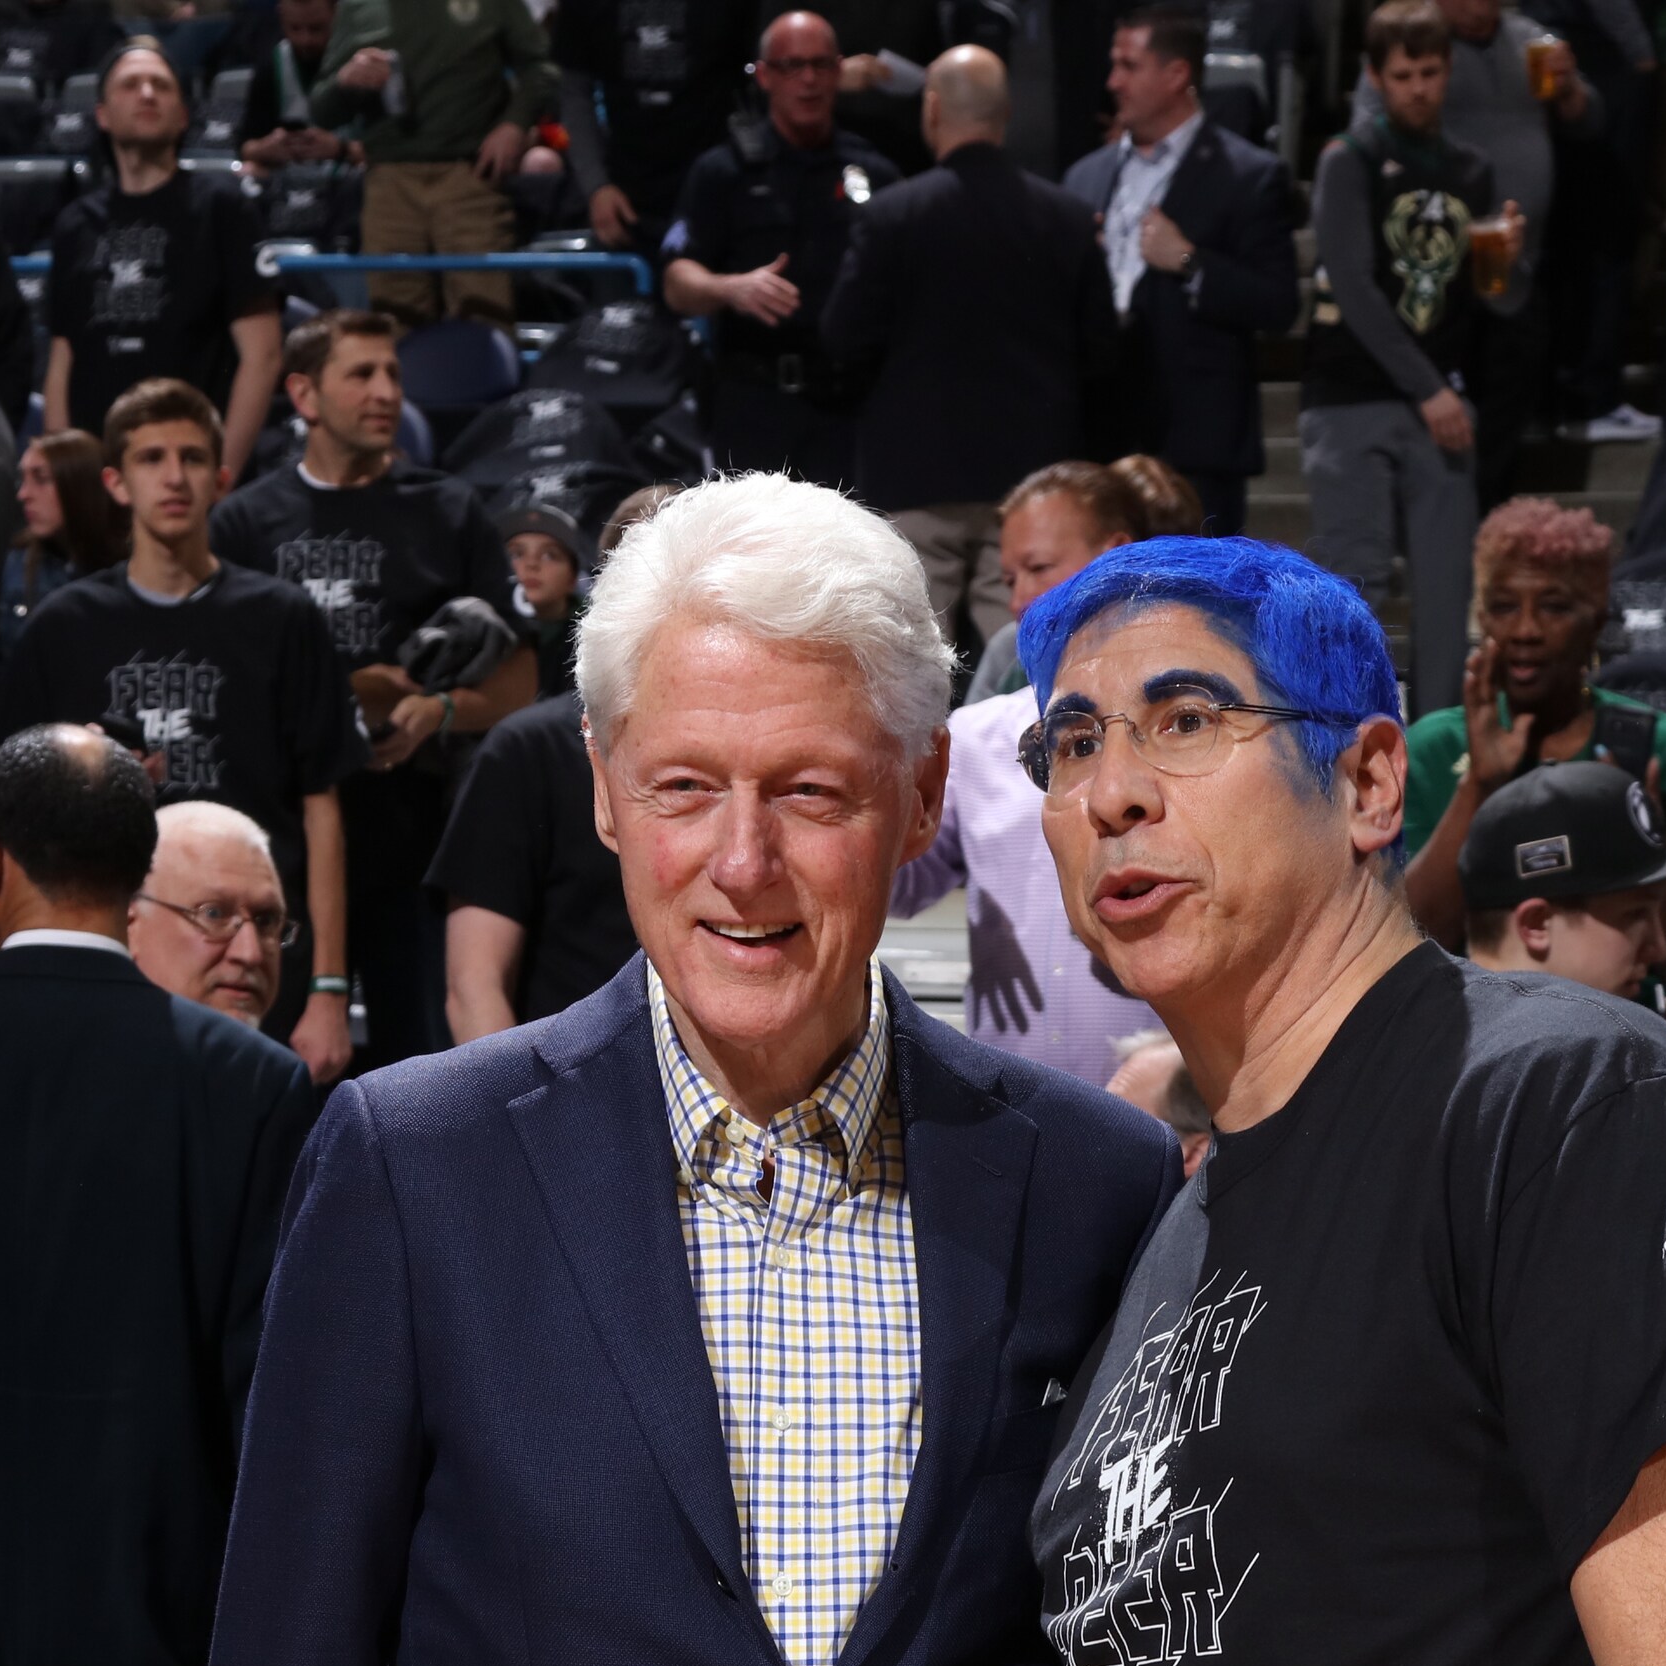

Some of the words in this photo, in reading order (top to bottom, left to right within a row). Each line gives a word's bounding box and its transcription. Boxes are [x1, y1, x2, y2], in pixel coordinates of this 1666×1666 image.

[301, 577, 355, 608] THE
[107, 660, 223, 722] FEAR
[136, 707, 194, 743] THE
[1067, 1284, 1263, 1490] FEAR
[1098, 1438, 1173, 1560] THE
